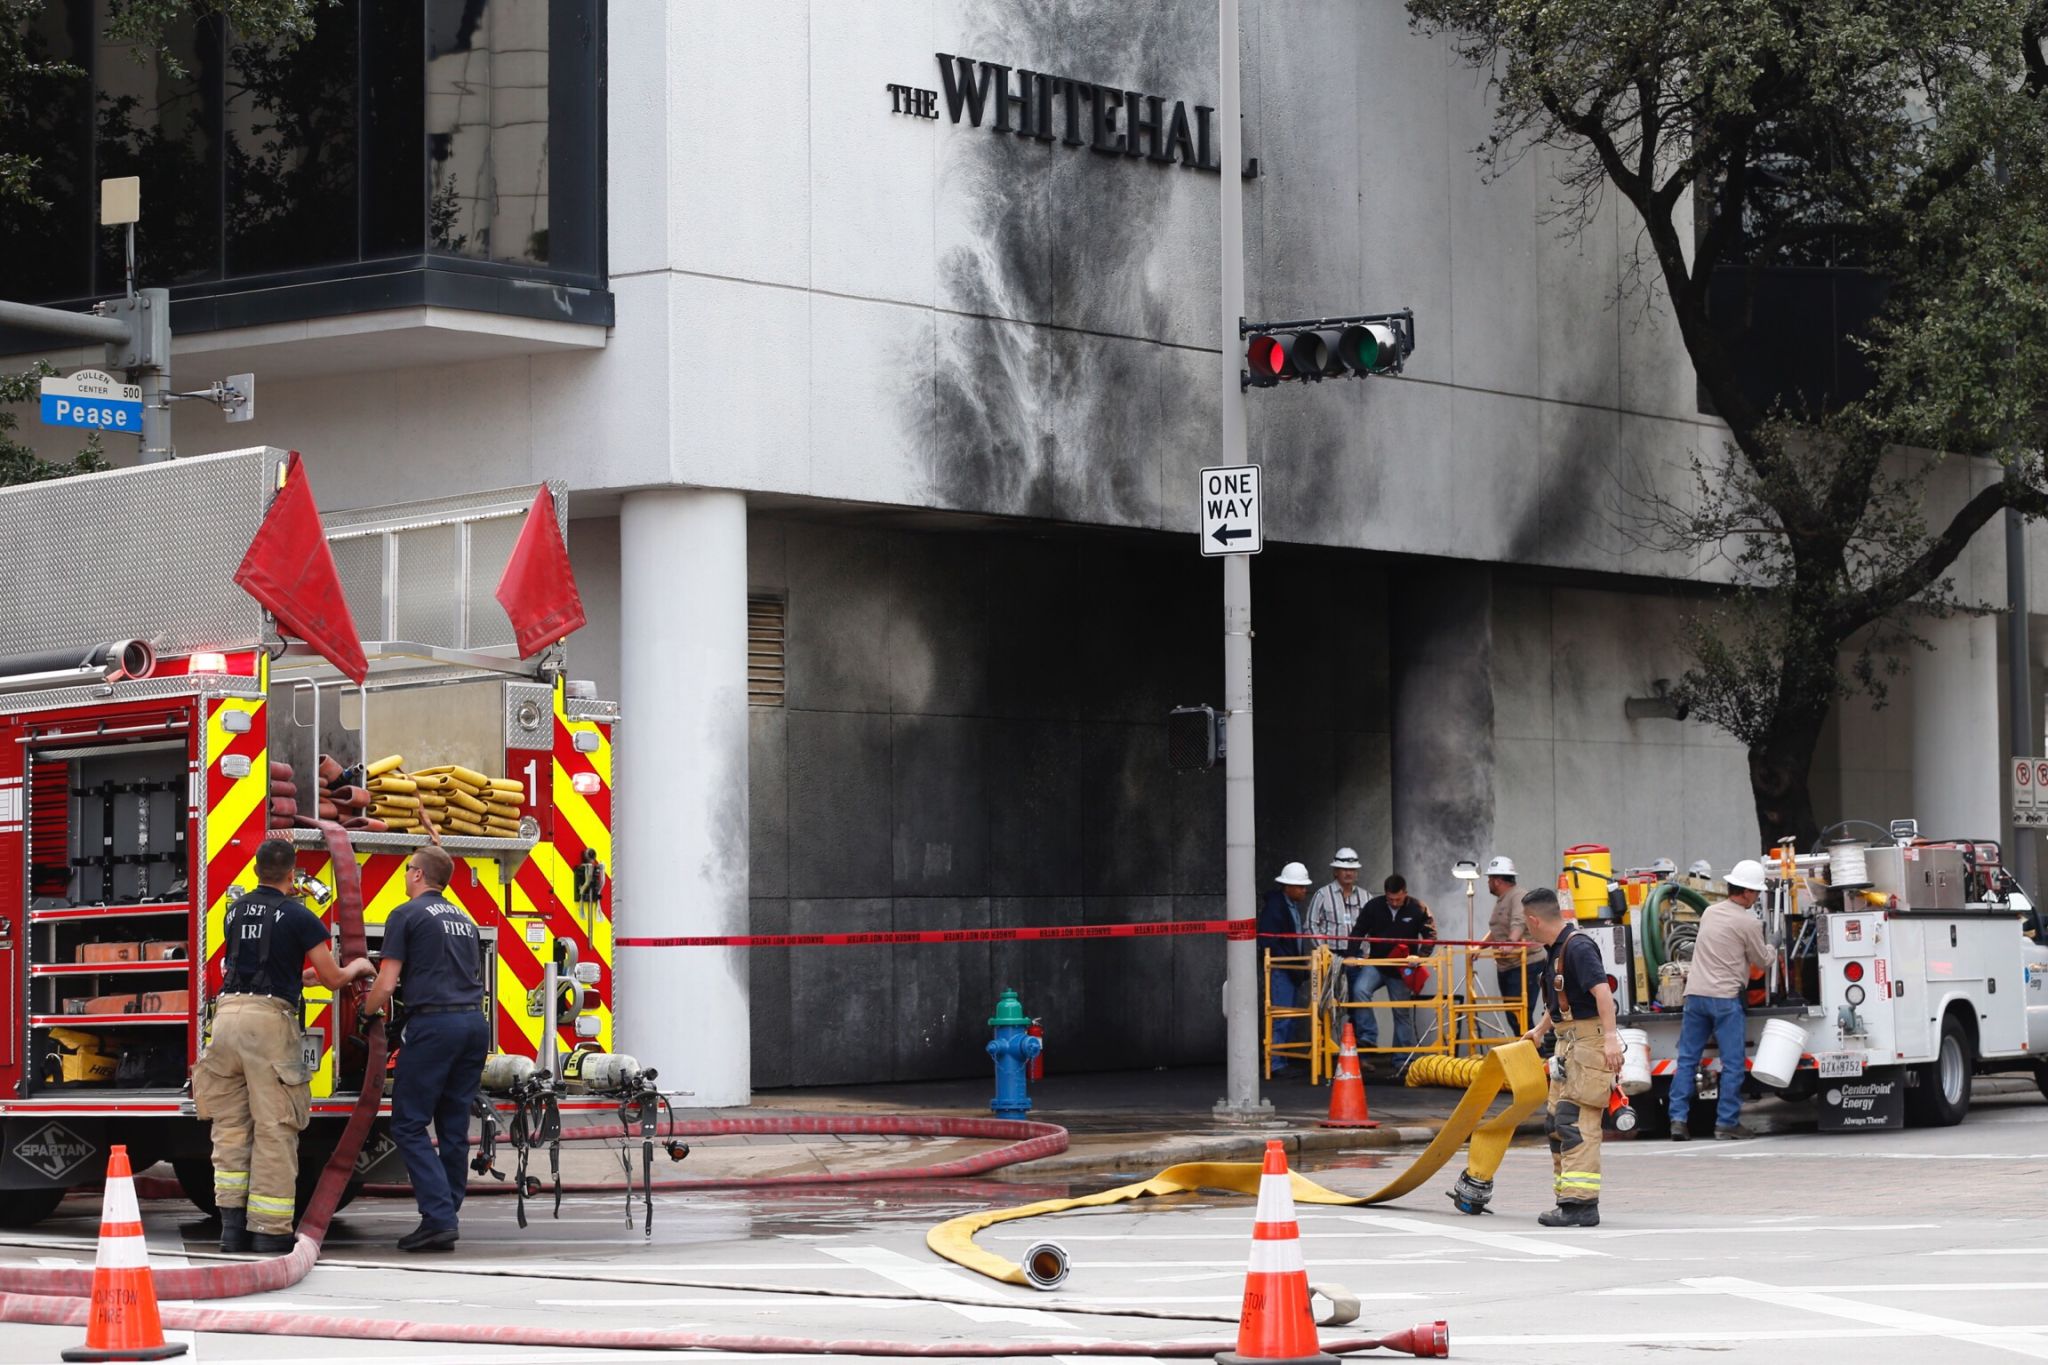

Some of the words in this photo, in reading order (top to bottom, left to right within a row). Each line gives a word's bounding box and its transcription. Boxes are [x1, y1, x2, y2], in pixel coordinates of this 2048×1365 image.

[887, 82, 939, 120] THE
[935, 52, 1258, 179] WHITEHAL
[76, 372, 111, 384] CULLEN
[78, 385, 108, 394] CENTER
[123, 387, 140, 399] 500
[56, 400, 127, 426] Pease
[1208, 473, 1252, 496] ONE
[1207, 498, 1253, 519] WAY
[523, 759, 537, 807] 1
[442, 920, 474, 938] FIRE
[303, 1049, 316, 1065] 64
[1841, 1083, 1892, 1095] CenterPoint
[1842, 1098, 1875, 1110] Energy
[1844, 1117, 1866, 1125] Always
[21, 1144, 87, 1157] SPARTAN
[94, 1288, 138, 1306] OUSTON
